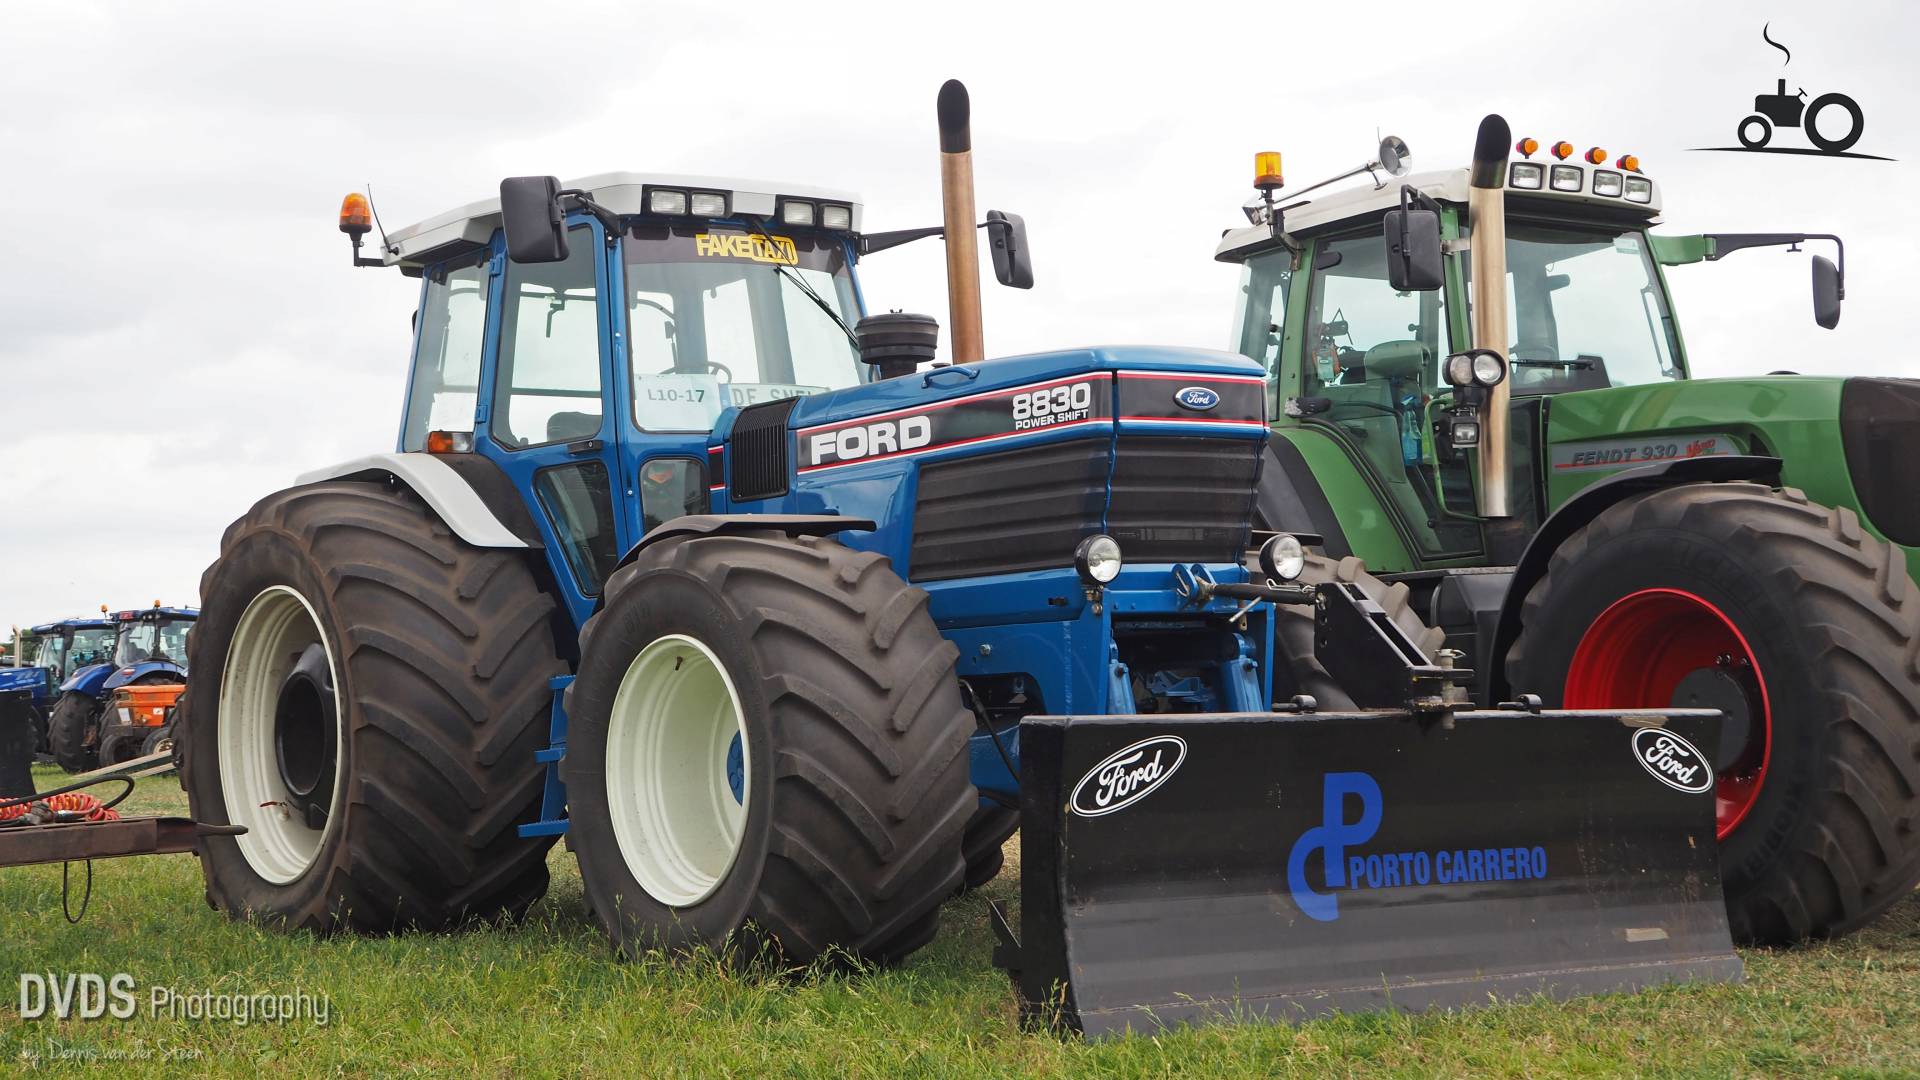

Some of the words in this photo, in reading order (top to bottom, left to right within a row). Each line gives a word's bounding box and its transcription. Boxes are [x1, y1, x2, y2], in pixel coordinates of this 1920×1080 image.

[647, 388, 705, 402] L10-17
[1012, 382, 1091, 420] 8830
[1015, 414, 1055, 430] POWER
[1057, 409, 1089, 423] SHIFT
[810, 415, 932, 466] FORD
[1571, 448, 1637, 466] FENDT
[1640, 443, 1679, 460] 930
[1350, 851, 1431, 890] PORTO
[1436, 846, 1547, 884] CARRERO
